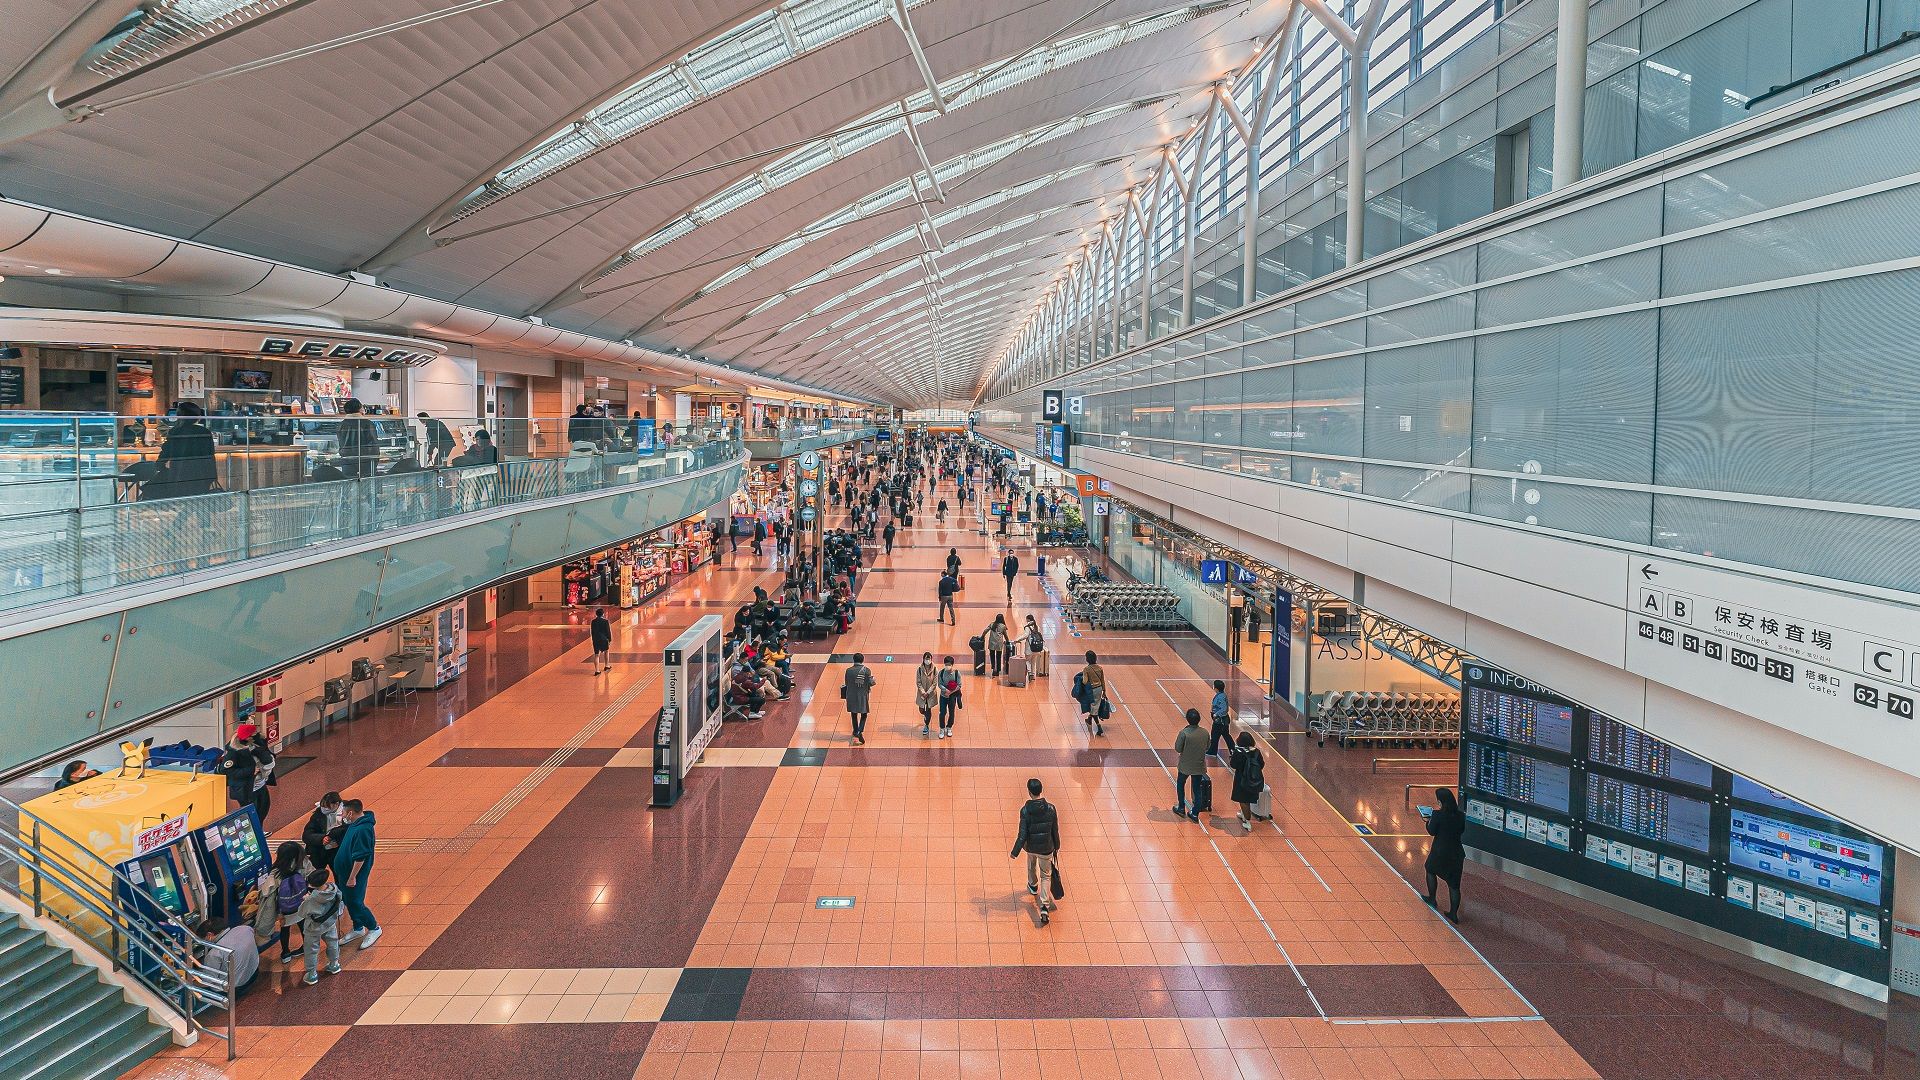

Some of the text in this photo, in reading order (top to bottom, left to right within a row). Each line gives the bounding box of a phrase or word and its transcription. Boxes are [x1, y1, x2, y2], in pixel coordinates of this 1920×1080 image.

[260, 337, 383, 361] BEER
[1046, 397, 1060, 415] B
[804, 454, 813, 467] 4
[1085, 480, 1094, 492] B
[1645, 594, 1685, 617] A B
[1713, 625, 1770, 647] Security Check
[1714, 605, 1833, 651] 保安検査場
[1640, 624, 1792, 679] 46 48 51 61 500 513
[1873, 651, 1892, 673] C
[670, 670, 678, 709] Informati
[1490, 670, 1554, 695] INFOR
[1805, 669, 1840, 688] 搭乗口
[1808, 682, 1837, 697] Gates
[1855, 688, 1911, 715] 62 70
[139, 818, 183, 846] ポケモン
